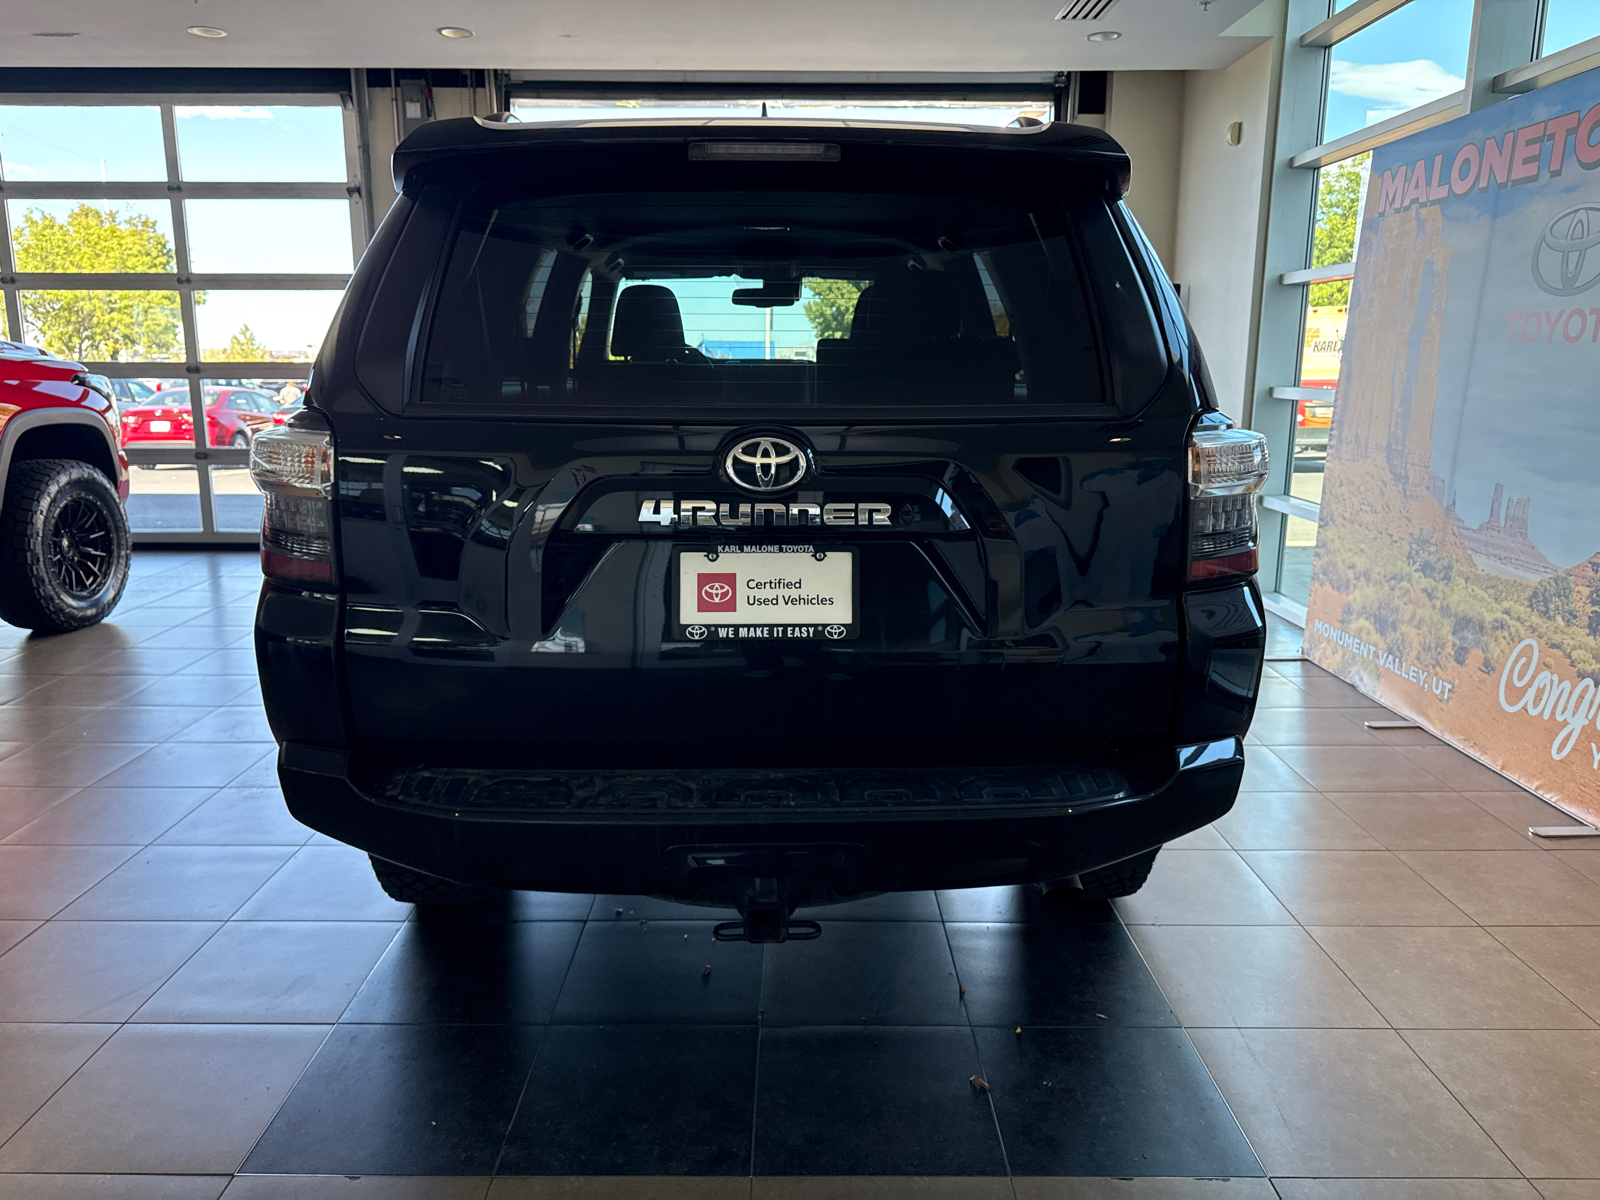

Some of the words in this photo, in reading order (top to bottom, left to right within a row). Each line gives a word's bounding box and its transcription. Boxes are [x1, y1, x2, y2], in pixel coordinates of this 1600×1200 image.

[1312, 341, 1338, 353] KARL
[717, 545, 741, 553] KARL
[743, 545, 780, 553] MALONE
[781, 545, 815, 553] TOYOTA
[746, 578, 802, 590] Certified
[746, 594, 779, 606] Used
[782, 594, 834, 606] Vehicles
[718, 627, 735, 638] WE
[738, 627, 770, 638] MAKE
[773, 627, 784, 638] IT
[787, 627, 815, 638] EASY
[1313, 618, 1377, 660] MONUMENT
[1378, 649, 1428, 692] VALLEY,
[1431, 676, 1453, 700] UT
